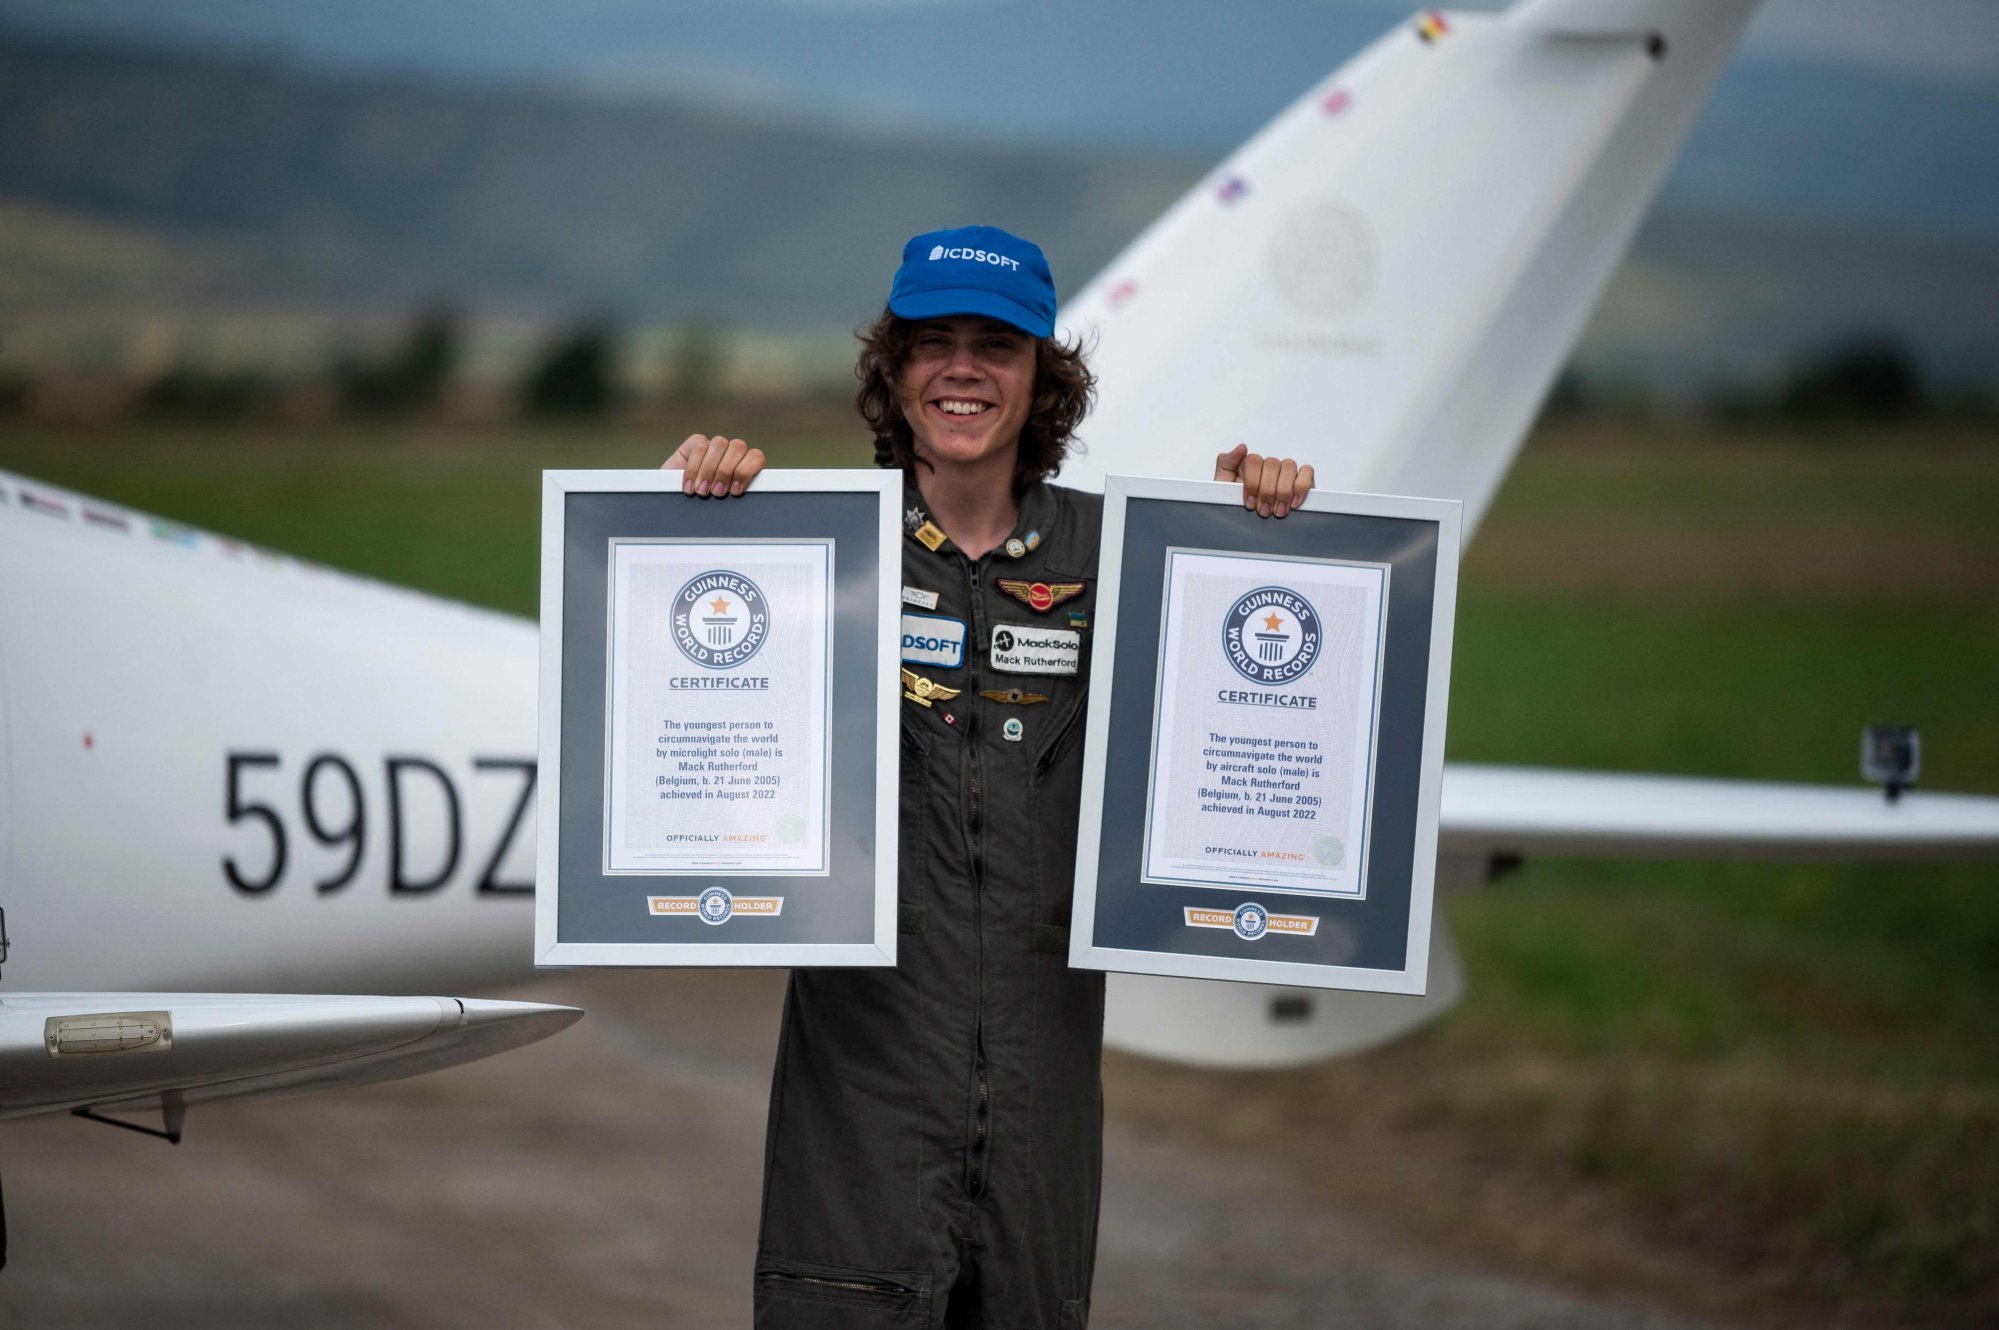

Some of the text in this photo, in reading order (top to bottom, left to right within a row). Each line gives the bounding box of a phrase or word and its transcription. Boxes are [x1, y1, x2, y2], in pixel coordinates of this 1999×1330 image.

[943, 248, 1020, 271] ICDSOFT
[684, 576, 757, 602] GUINNESS
[1238, 592, 1310, 621] GUINNESS
[675, 613, 764, 664] WORLD RECORDS
[1017, 638, 1079, 651] MackSolo
[995, 653, 1077, 668] Mack Rutherford
[1228, 627, 1317, 680] WORLD RECORDS
[669, 677, 769, 688] CERTIFICATE
[1218, 690, 1317, 708] CERTIFICATE
[663, 720, 773, 731] The youngest person to
[658, 734, 779, 745] circumnavigate the world
[1209, 733, 1319, 750] The youngest person to
[656, 748, 783, 759] by microlight solo (male) is
[1203, 746, 1323, 765] circumnavigate the world
[678, 762, 758, 771] Mack Rutherford
[1206, 761, 1320, 778] by aircraft solo (male) is
[655, 775, 780, 787] (Belgium, b. 21 June 2005)
[1221, 776, 1301, 791] Mack Rutherford
[660, 790, 776, 801] achieved in August 2022
[1197, 788, 1322, 807] (Belgium, b. 21 June 2005)
[1201, 803, 1316, 820] achieved in August 2022
[221, 749, 537, 899] 59DZ
[666, 834, 767, 842] OFFICIALLY AMAZING
[1205, 846, 1305, 861] OFFICIALLY AMAZING
[657, 902, 774, 910] RECORD HOLDER
[1193, 913, 1308, 930] RECORD HOLDER
